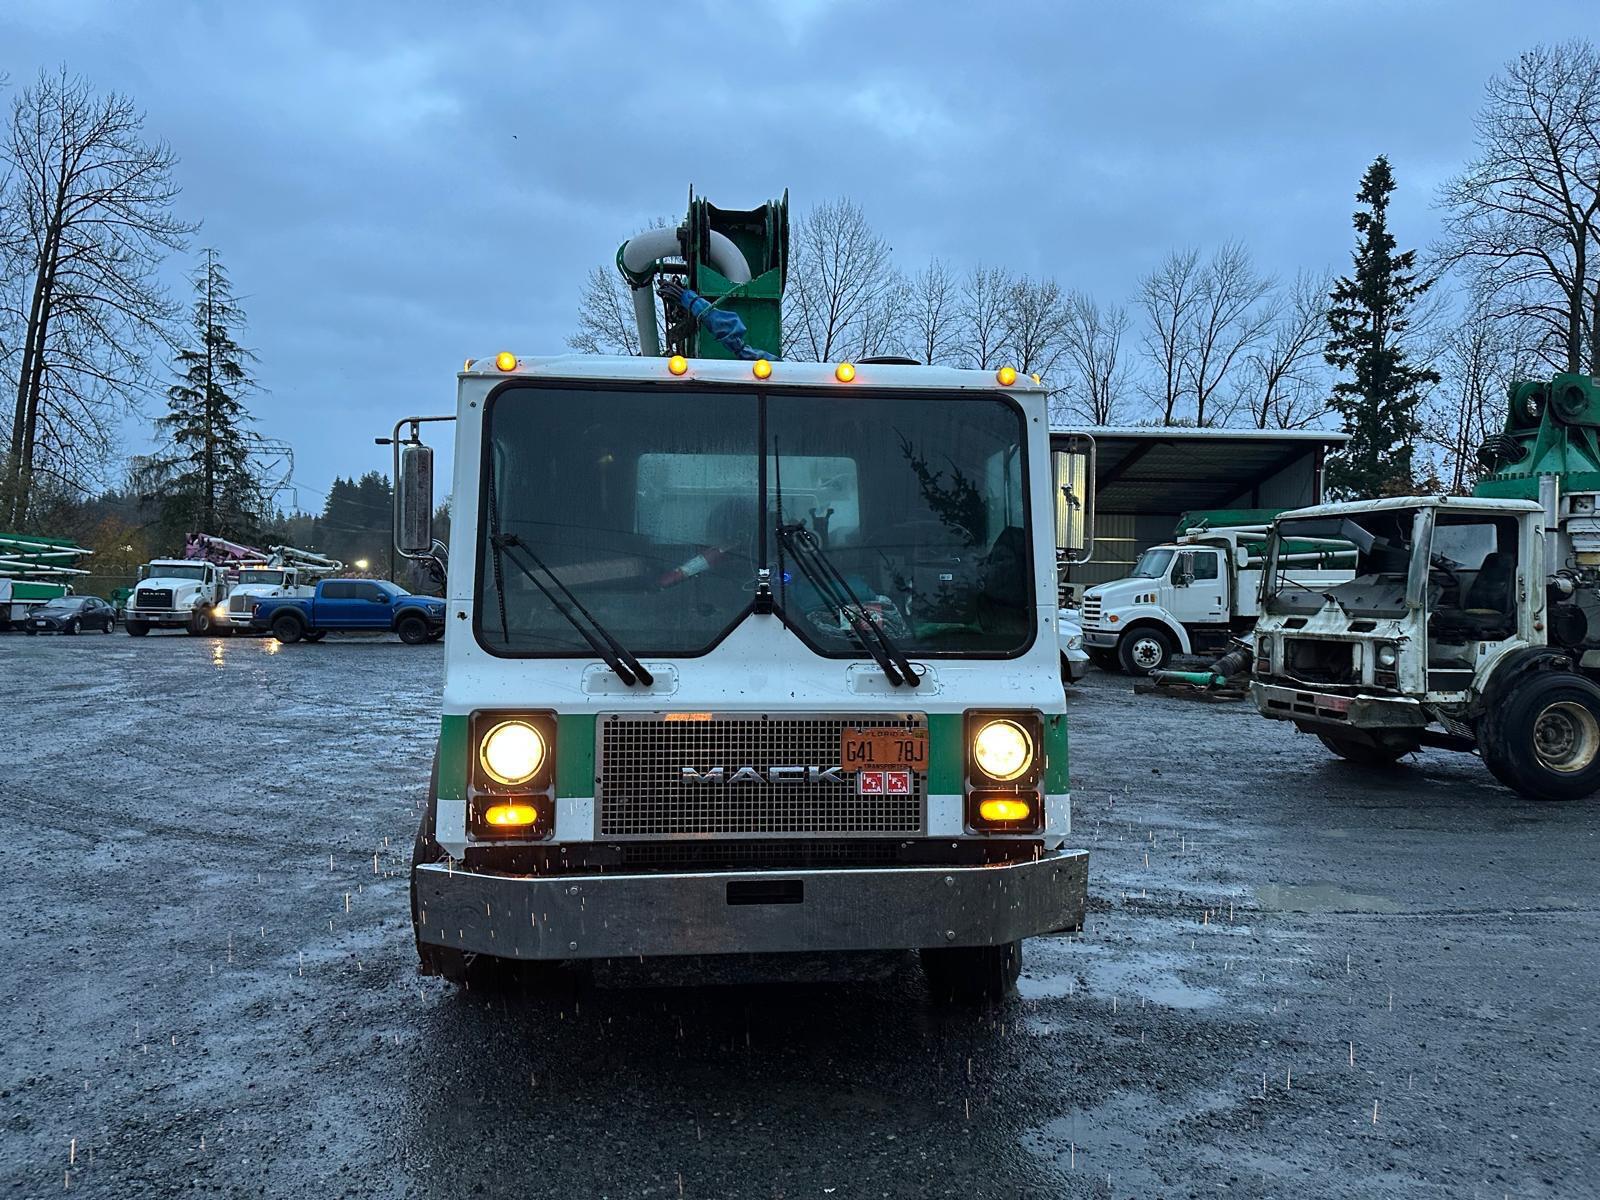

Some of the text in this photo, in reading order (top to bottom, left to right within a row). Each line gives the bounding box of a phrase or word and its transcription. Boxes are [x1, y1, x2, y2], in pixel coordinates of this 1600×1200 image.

[847, 741, 923, 762] G41 78J
[682, 766, 845, 784] MACK
